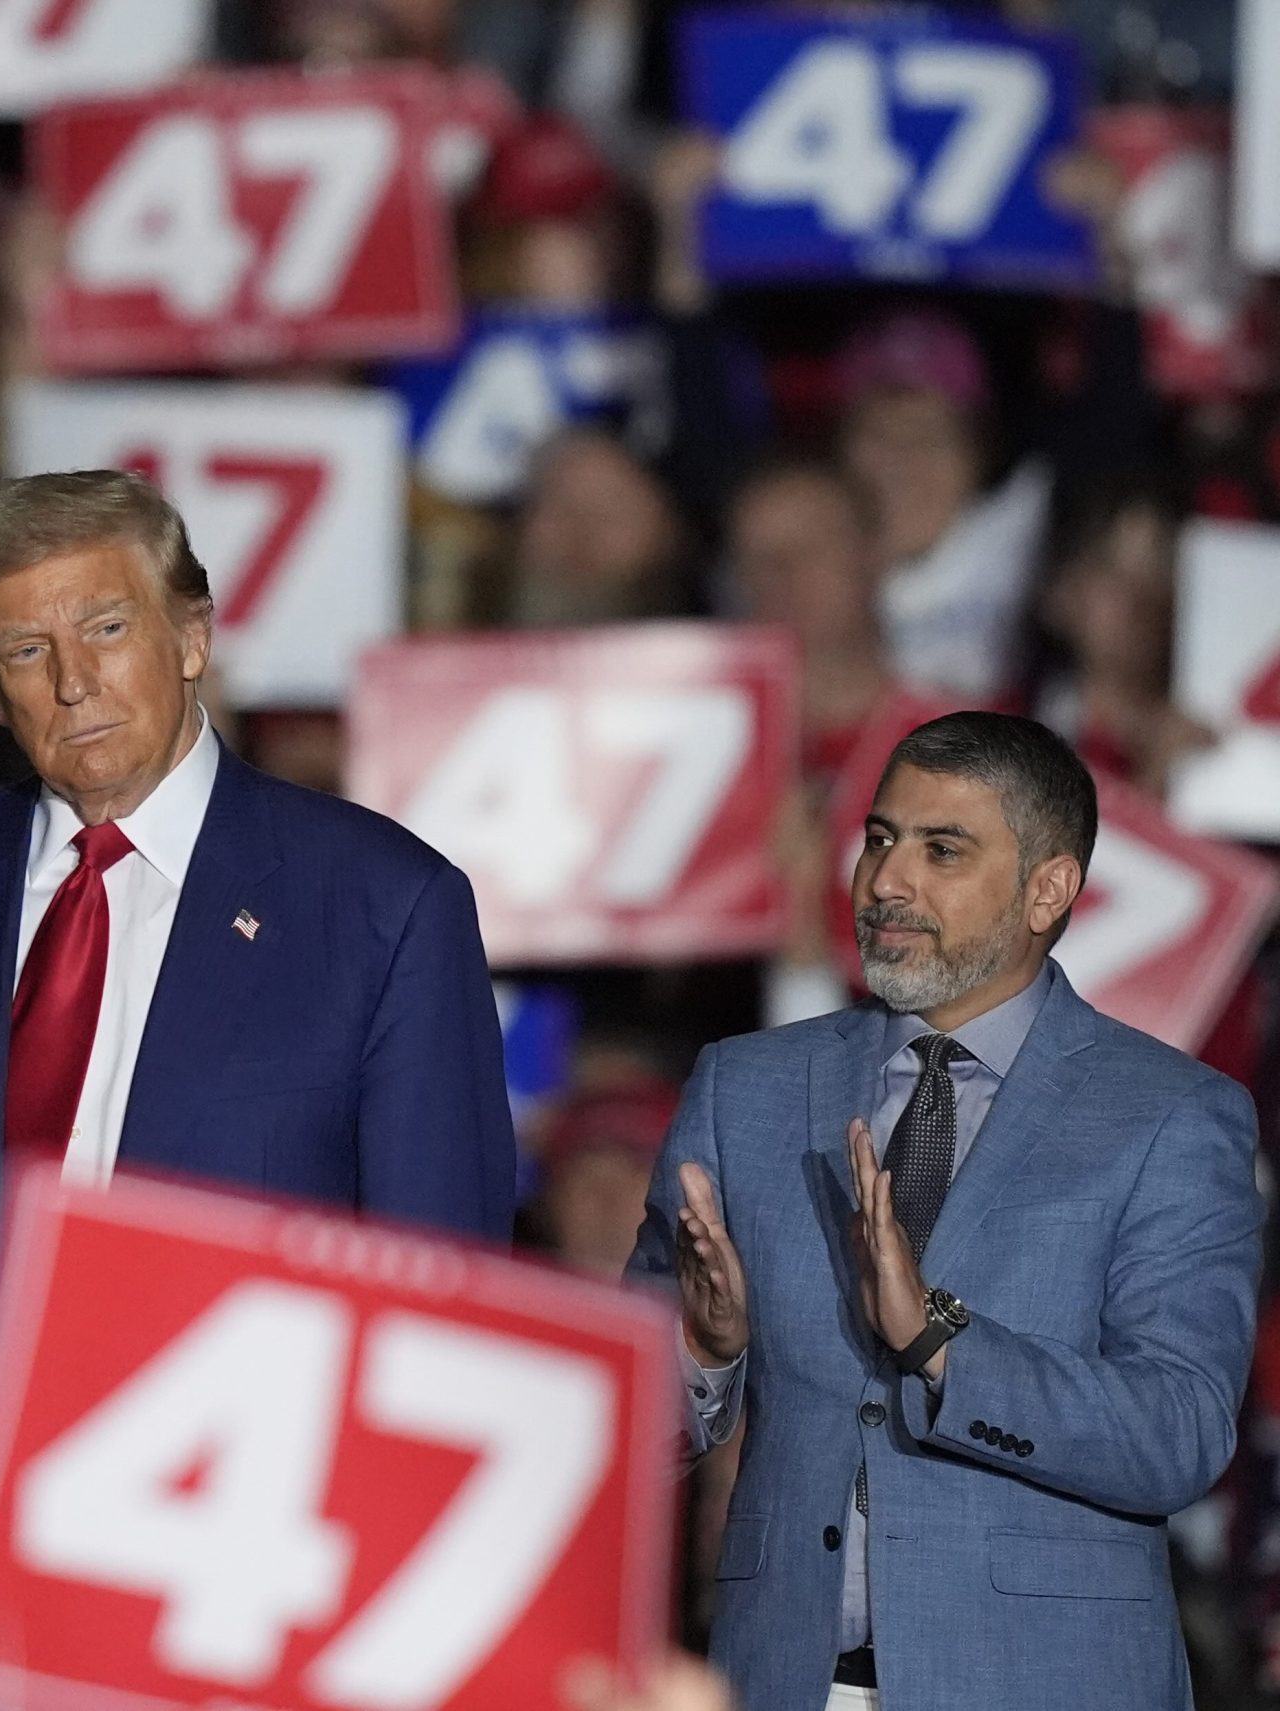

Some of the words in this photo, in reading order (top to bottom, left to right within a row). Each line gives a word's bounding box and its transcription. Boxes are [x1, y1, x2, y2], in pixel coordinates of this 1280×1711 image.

[67, 108, 397, 323] 47
[722, 36, 1051, 240] 47
[400, 687, 753, 903] 47
[10, 1276, 618, 1708] 47
